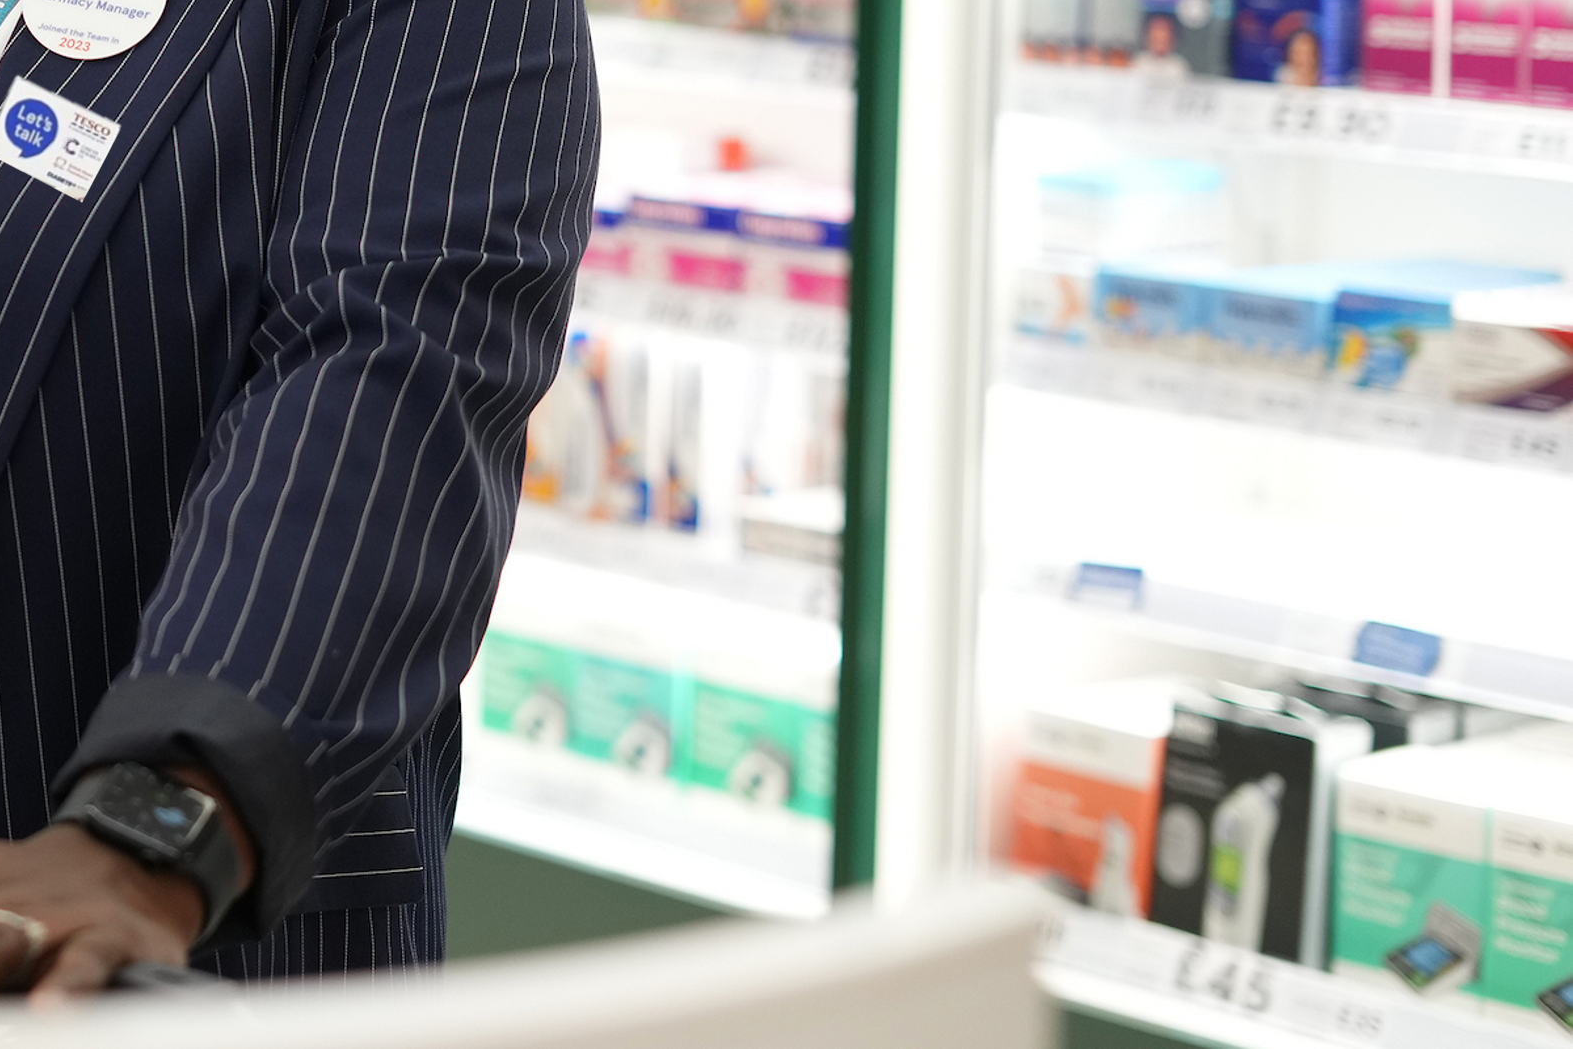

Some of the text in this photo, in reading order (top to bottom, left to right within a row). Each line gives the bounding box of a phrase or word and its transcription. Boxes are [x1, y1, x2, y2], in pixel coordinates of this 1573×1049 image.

[95, 0, 151, 20] Manager
[37, 22, 69, 35] Joined
[69, 28, 85, 38] the
[86, 32, 110, 43] Team
[59, 36, 91, 52] 2023
[17, 104, 53, 133] Let's
[74, 112, 112, 137] TESCO
[14, 122, 44, 148] talk
